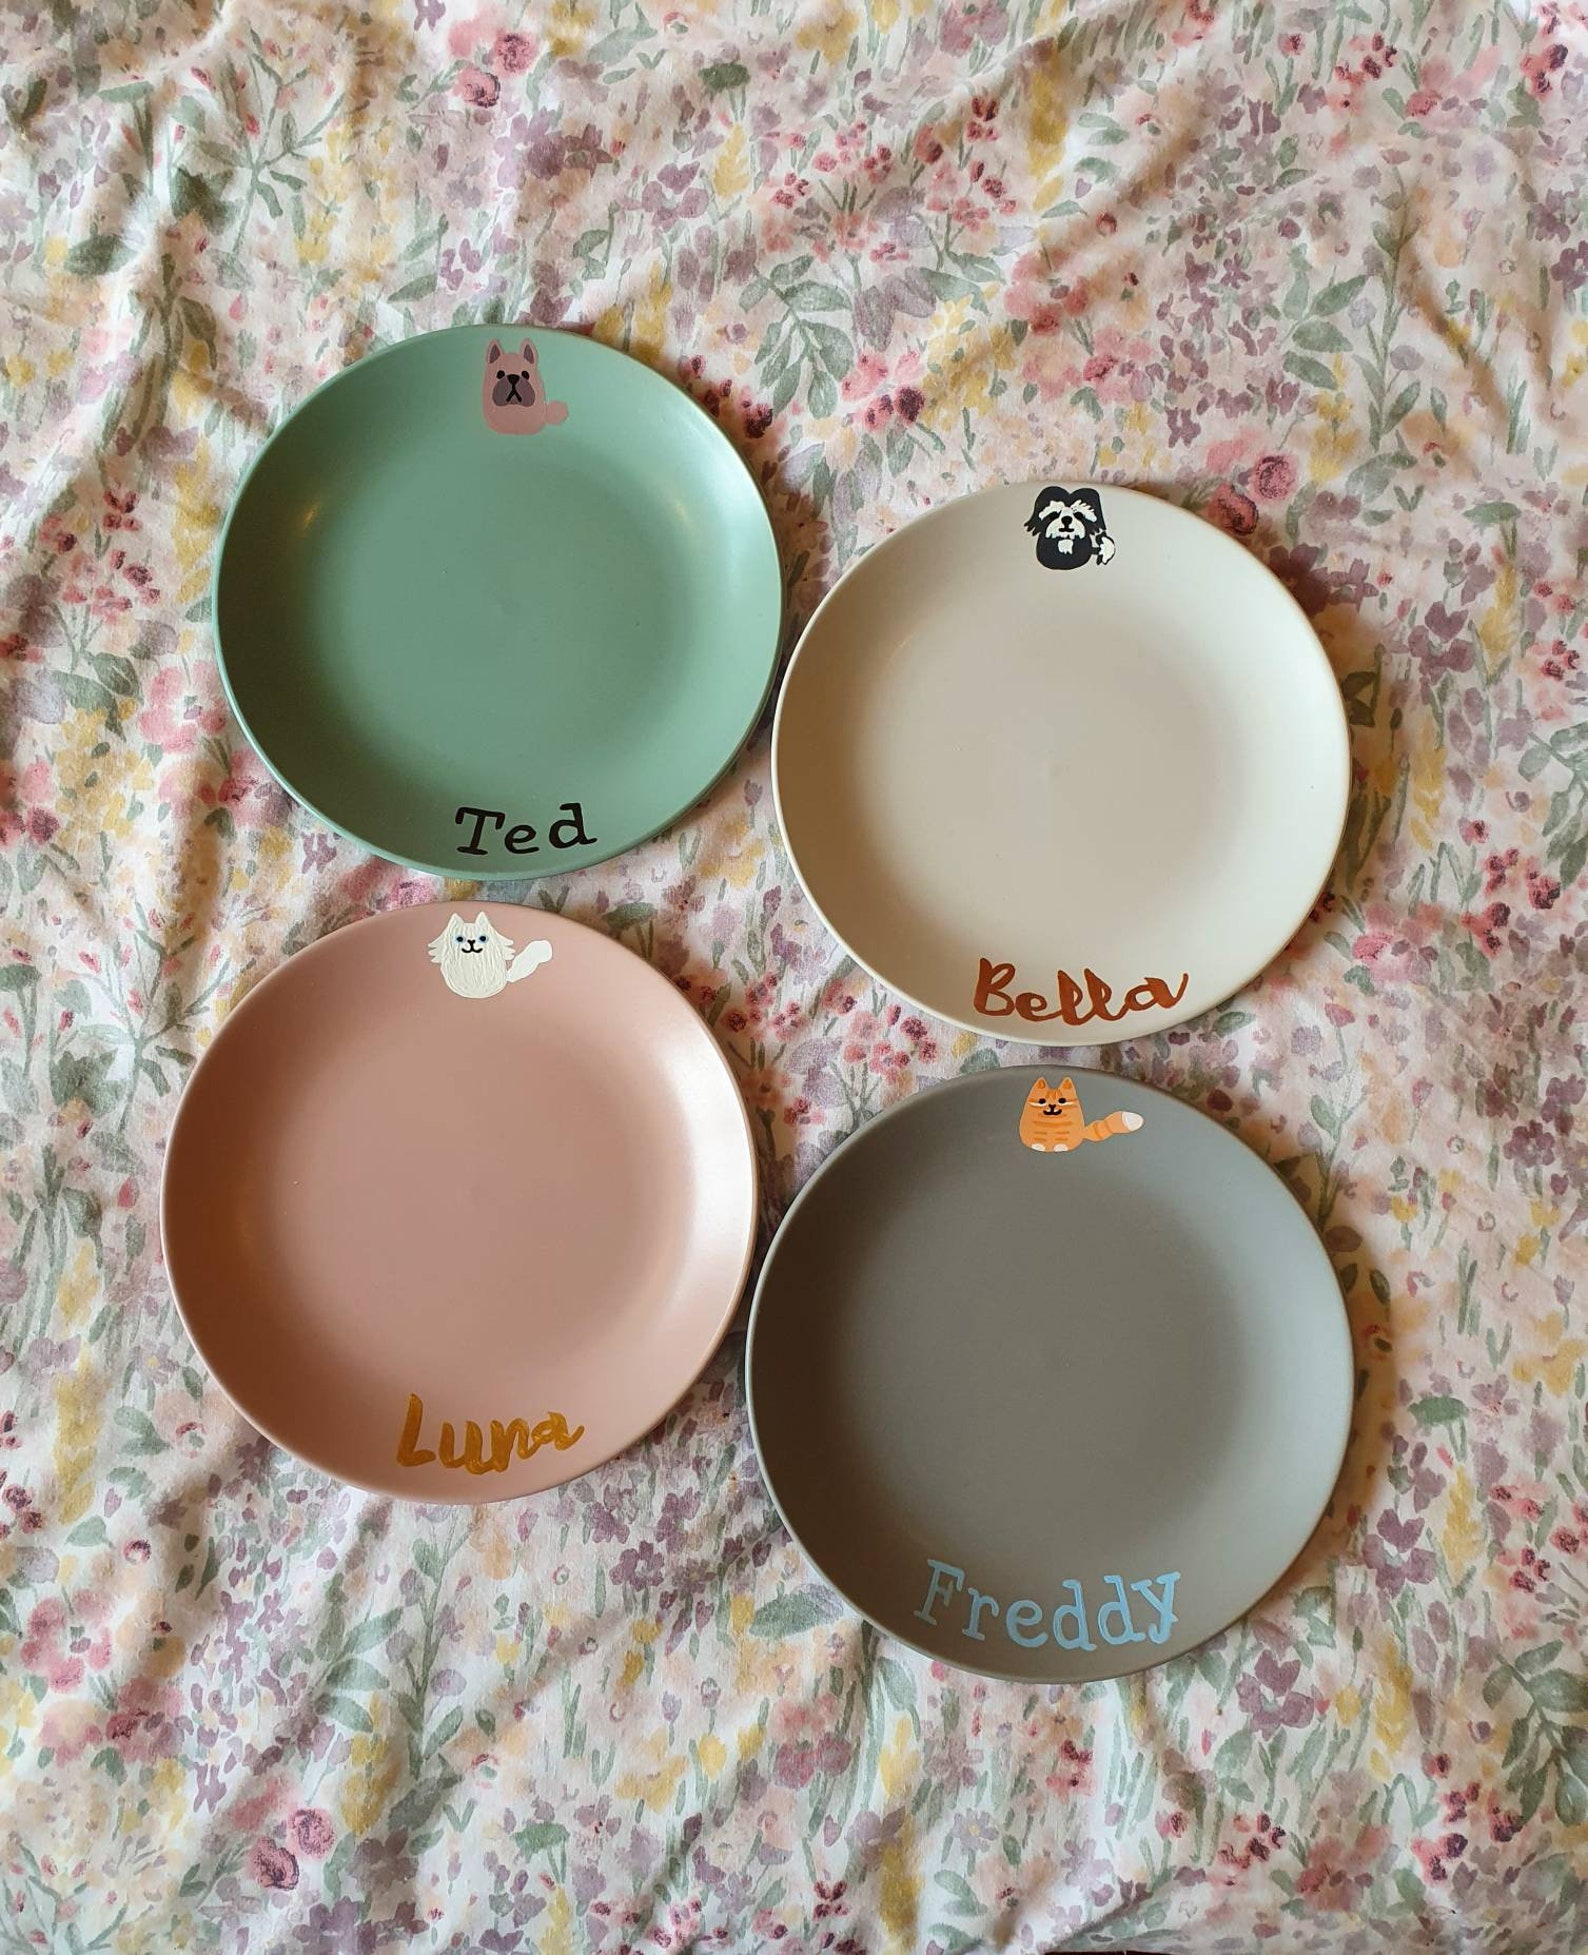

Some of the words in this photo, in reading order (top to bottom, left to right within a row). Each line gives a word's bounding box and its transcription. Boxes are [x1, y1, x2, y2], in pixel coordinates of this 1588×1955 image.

[455, 802, 598, 856] Ted
[973, 957, 1189, 1026] Bella
[396, 1393, 585, 1475] Luna
[913, 1559, 1181, 1651] Freddy
